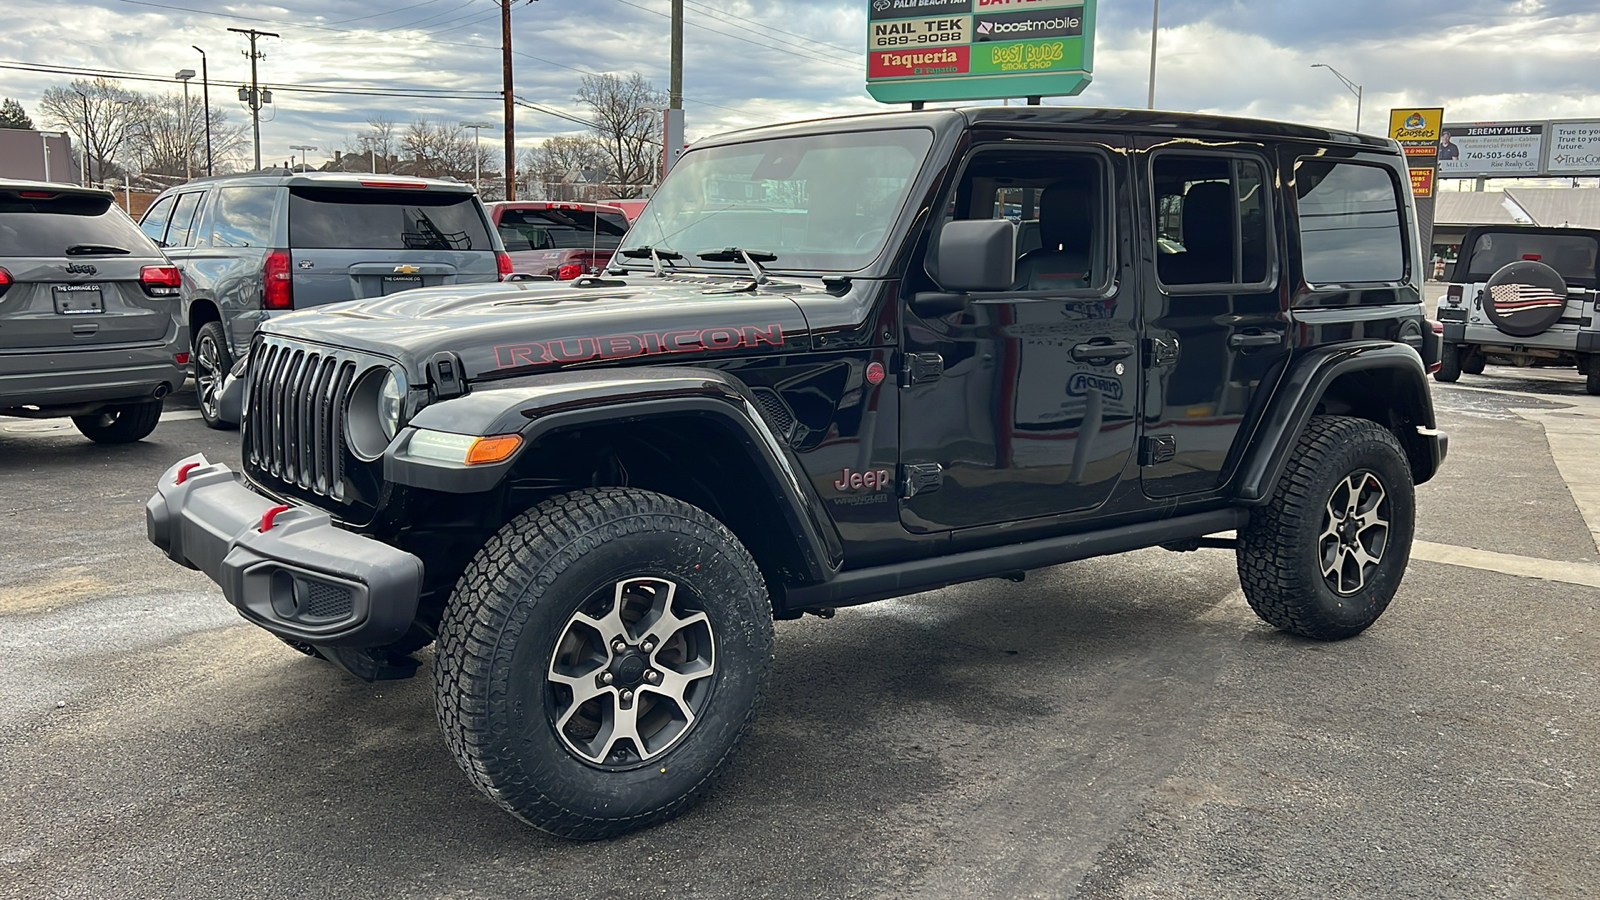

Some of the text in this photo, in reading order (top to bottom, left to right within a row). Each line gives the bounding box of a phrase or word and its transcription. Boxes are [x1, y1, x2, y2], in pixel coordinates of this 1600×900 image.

[893, 0, 918, 9] PALM
[875, 18, 963, 36] NAIL TEK
[994, 17, 1080, 33] boostmobile
[877, 32, 962, 46] 689-9088
[1025, 41, 1064, 62] BUDZ
[1001, 61, 1052, 71] SMOKE SHOP
[1395, 127, 1435, 139] Roosters
[1467, 126, 1532, 136] JEREMY MILLS
[1466, 151, 1528, 160] 740-503-6648
[1504, 161, 1523, 169] Realty
[65, 262, 98, 276] Jeep
[493, 323, 785, 368] RUBICON
[833, 467, 890, 492] Jeep
